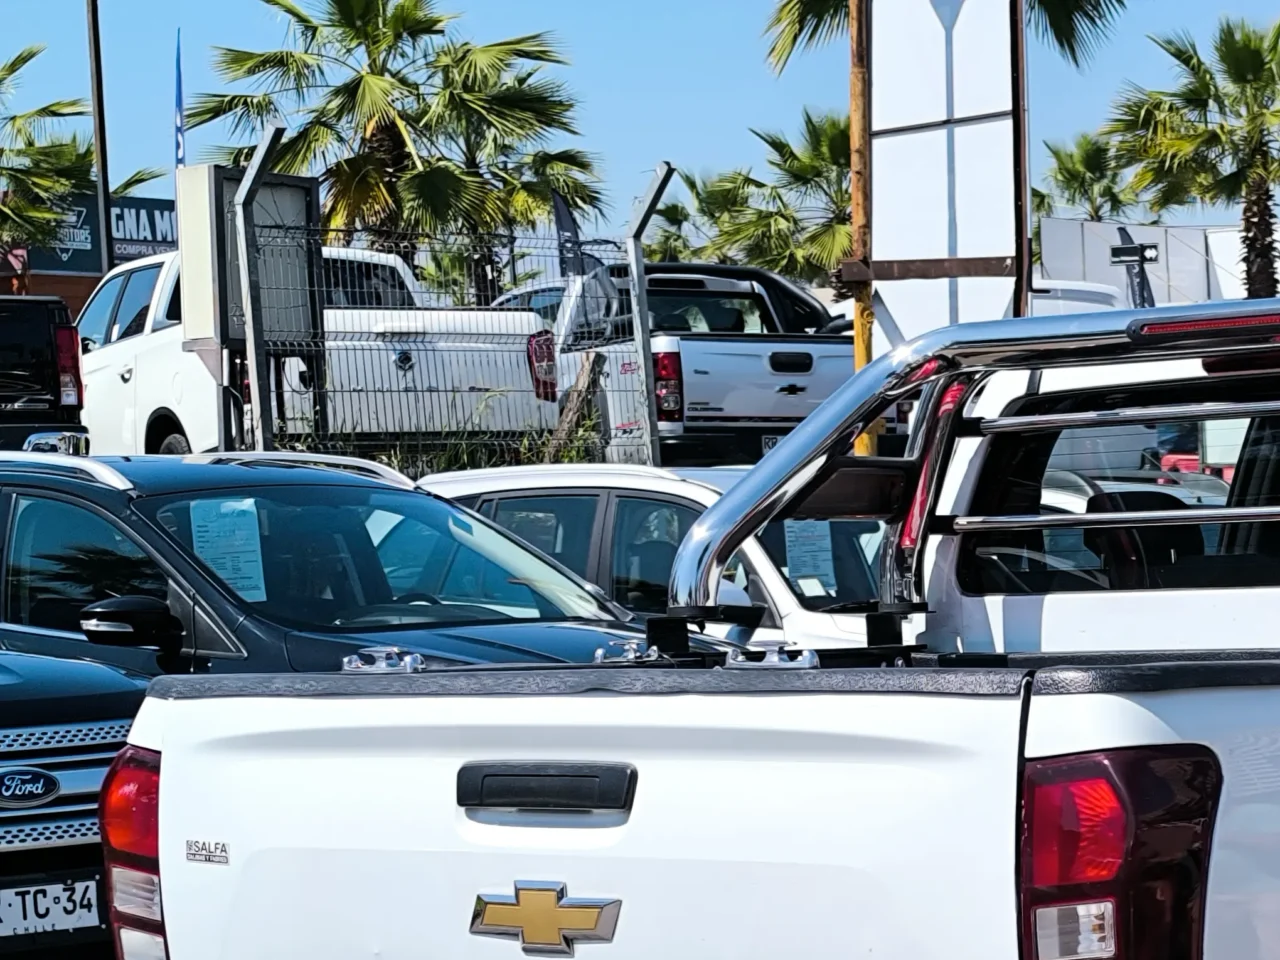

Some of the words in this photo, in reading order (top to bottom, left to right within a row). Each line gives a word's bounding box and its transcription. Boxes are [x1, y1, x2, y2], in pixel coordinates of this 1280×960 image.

[114, 243, 155, 255] COMPRA
[1, 774, 46, 797] Ford
[193, 840, 228, 854] SALFA
